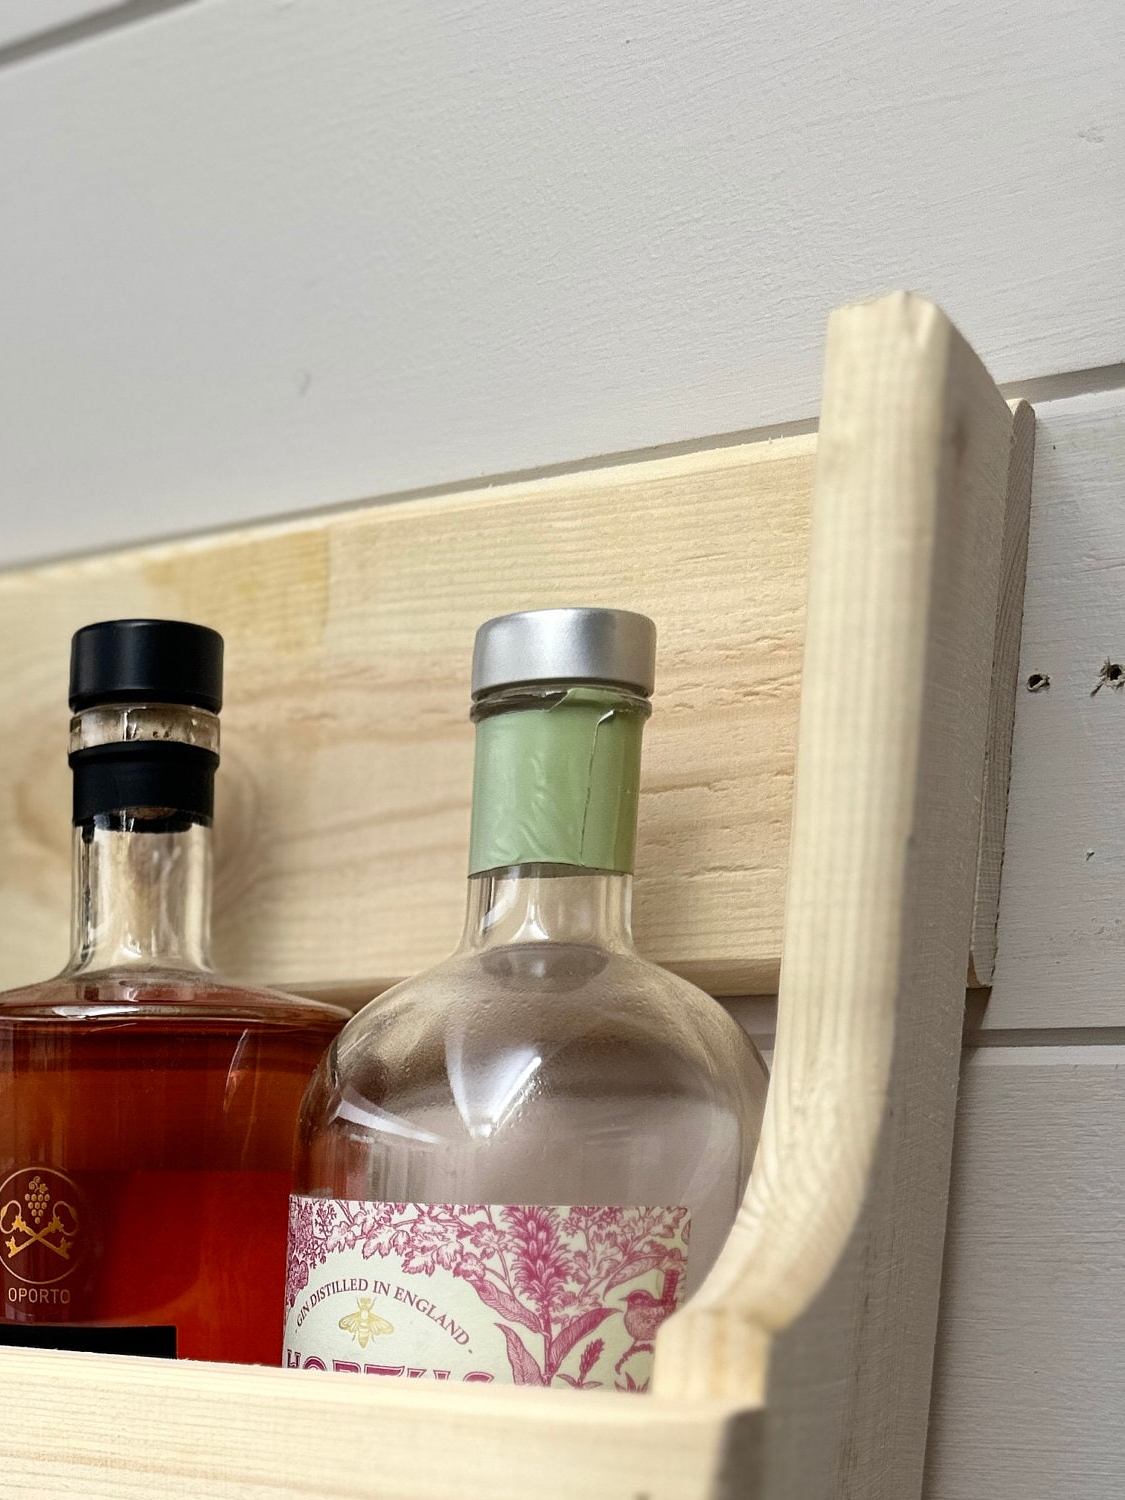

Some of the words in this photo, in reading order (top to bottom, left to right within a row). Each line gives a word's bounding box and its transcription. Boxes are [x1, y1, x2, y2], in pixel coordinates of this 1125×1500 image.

[8, 1287, 71, 1305] OPORTO
[296, 1304, 310, 1328] GIN
[310, 1278, 368, 1307] DISTILLED
[372, 1280, 391, 1297] IN
[393, 1286, 471, 1346] ENGLAND
